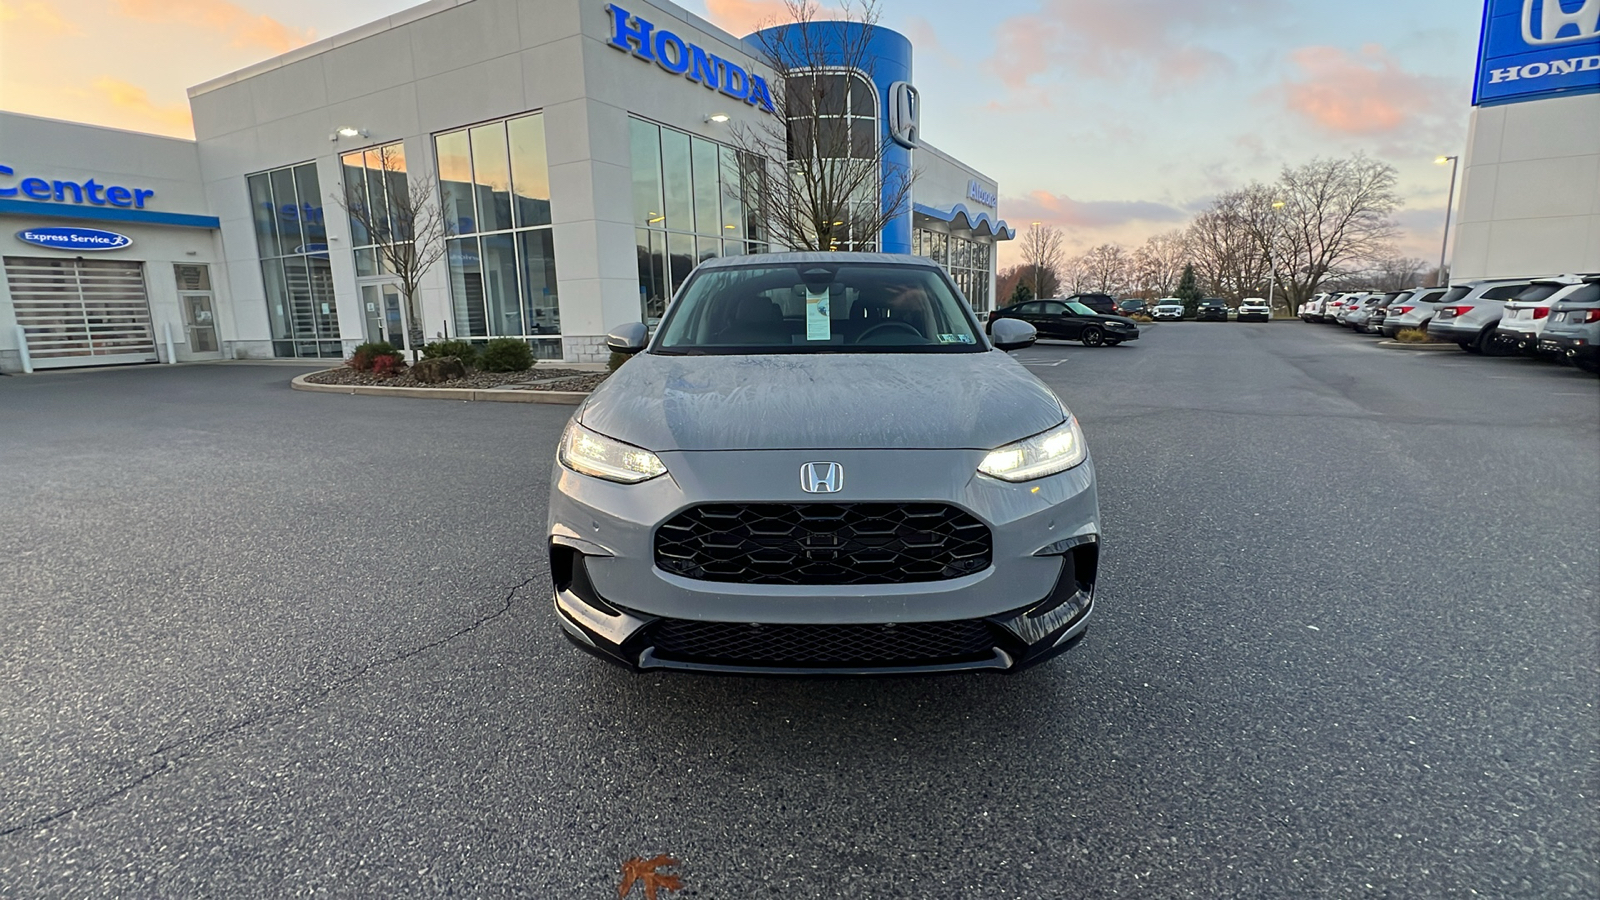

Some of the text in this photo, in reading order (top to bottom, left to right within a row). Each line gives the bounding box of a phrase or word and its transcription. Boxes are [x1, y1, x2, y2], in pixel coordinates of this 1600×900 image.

[606, 3, 775, 113] HONDA
[24, 232, 110, 244] Express Service
